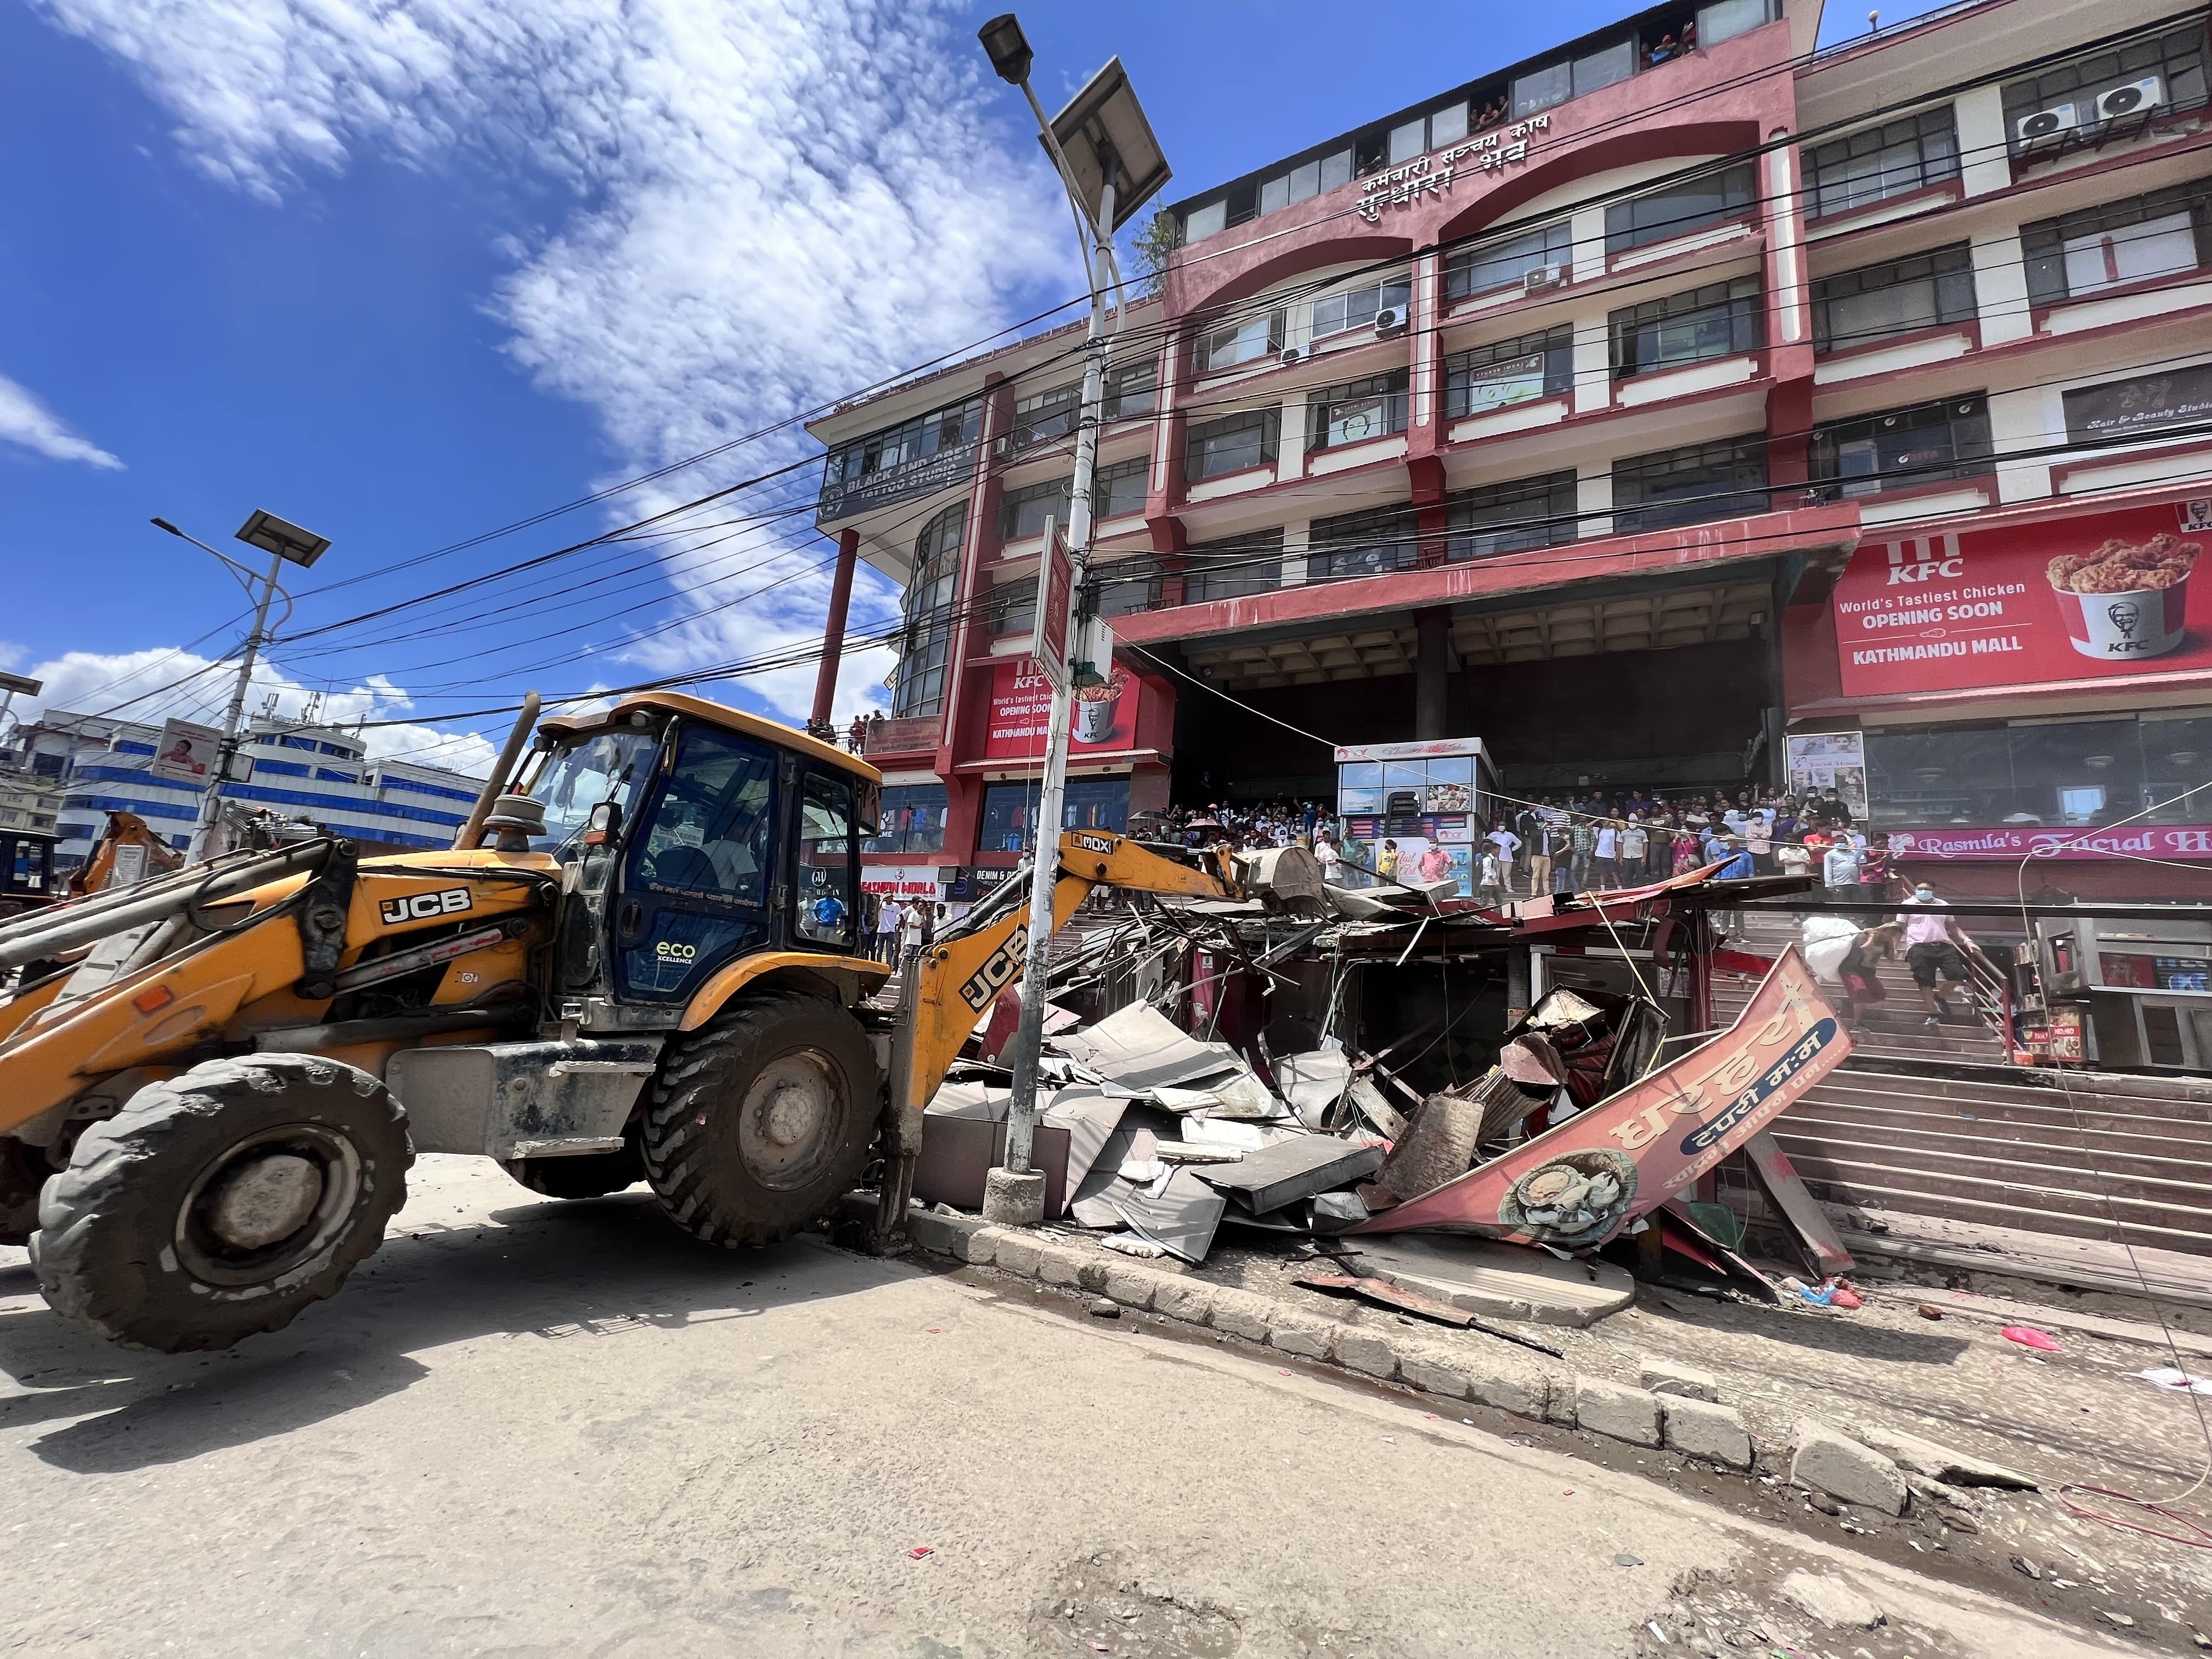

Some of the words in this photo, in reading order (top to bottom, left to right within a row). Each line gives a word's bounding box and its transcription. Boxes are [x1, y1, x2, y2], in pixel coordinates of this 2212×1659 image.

[1362, 156, 1431, 192] कर्मचारी
[2086, 420, 2115, 430] Hair
[2118, 415, 2130, 424] &
[2132, 408, 2175, 422] Beauty
[847, 469, 893, 493] BLACK
[898, 458, 928, 476] AND
[860, 478, 906, 499] TATTOO
[909, 464, 957, 487] STUDIO
[1887, 558, 1964, 586] KFC
[1839, 598, 1893, 614] World's
[1897, 589, 1958, 607] Tastiest
[1963, 583, 2025, 600] Chicken
[1862, 608, 1943, 629] OPENING
[1948, 601, 2003, 620] SOON
[1853, 641, 1967, 665] KATHMANDU
[1971, 636, 2023, 654] MALL
[2108, 639, 2151, 652] KFC
[1013, 675, 1045, 689] KFC
[993, 697, 1014, 706] World's
[1015, 695, 1038, 704] Tastiest
[1000, 705, 1030, 716] OPENING
[992, 726, 1035, 739] KATHMANDU
[1918, 832, 2021, 859] Rasmila's
[2029, 832, 2157, 857] Facial
[861, 882, 899, 894] FASHION
[901, 882, 936, 894] WORLD
[977, 870, 998, 880] DENIM
[999, 871, 1005, 880] &
[383, 889, 470, 922] JCB
[656, 941, 696, 958] eco
[657, 955, 692, 964] XCELLENCE
[970, 930, 1028, 1008] JCB
[1691, 1087, 1759, 1147] टपरी
